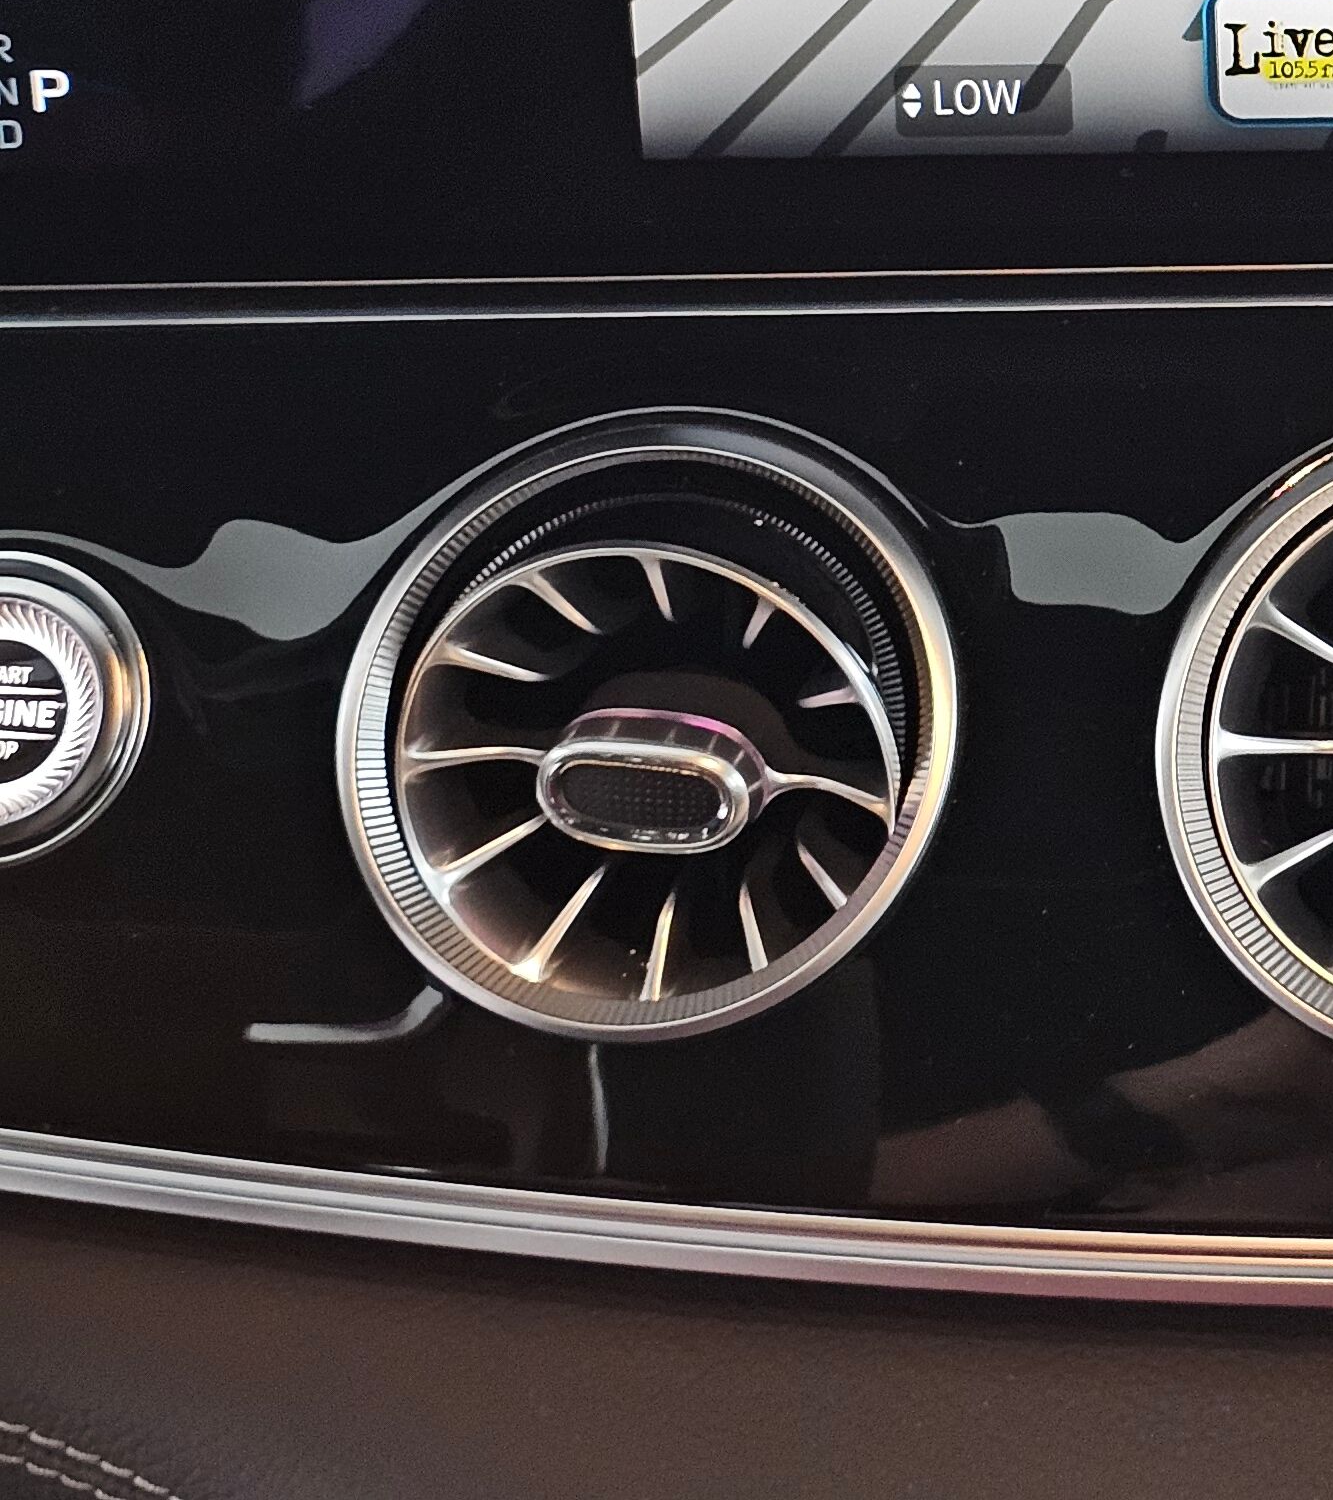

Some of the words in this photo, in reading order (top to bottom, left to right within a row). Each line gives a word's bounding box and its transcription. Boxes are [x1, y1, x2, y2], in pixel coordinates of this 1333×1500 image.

[30, 70, 69, 112] P
[934, 80, 1020, 115] LOW
[0, 120, 22, 149] D
